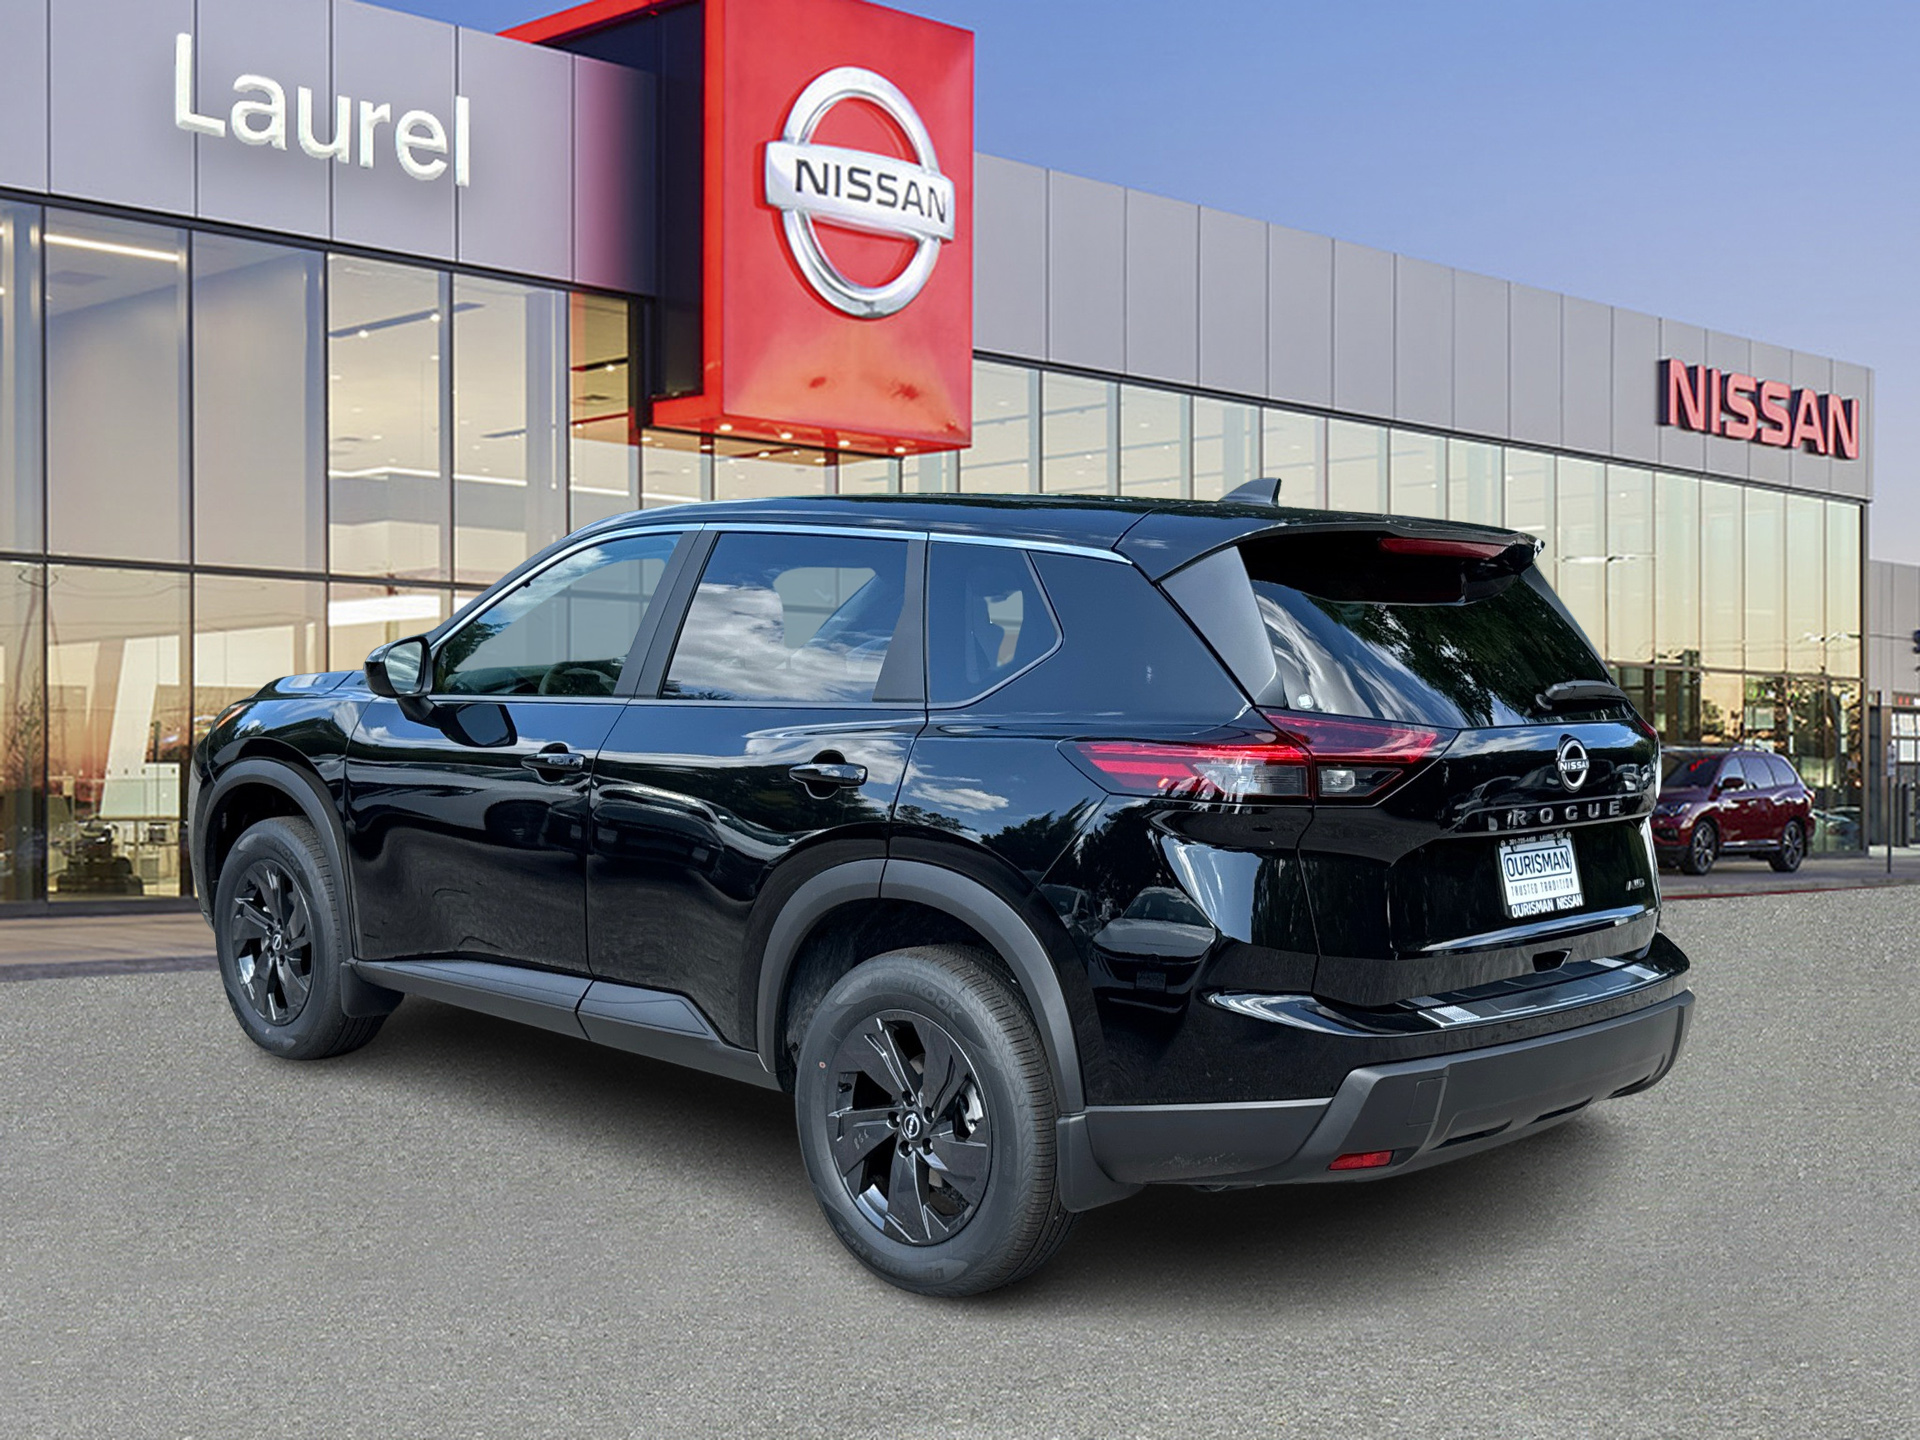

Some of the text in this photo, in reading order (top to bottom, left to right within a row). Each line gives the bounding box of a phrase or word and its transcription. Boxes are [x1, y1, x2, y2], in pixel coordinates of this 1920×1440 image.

[175, 32, 470, 187] Laurel
[795, 158, 946, 224] NISSAN
[1658, 358, 1859, 460] NISSAN
[1512, 800, 1620, 826] ROGUE
[1506, 851, 1570, 877] OURISMAN
[1511, 878, 1574, 896] TRUSTED TRADITION
[1511, 893, 1583, 918] OURISMAN NISSAN
